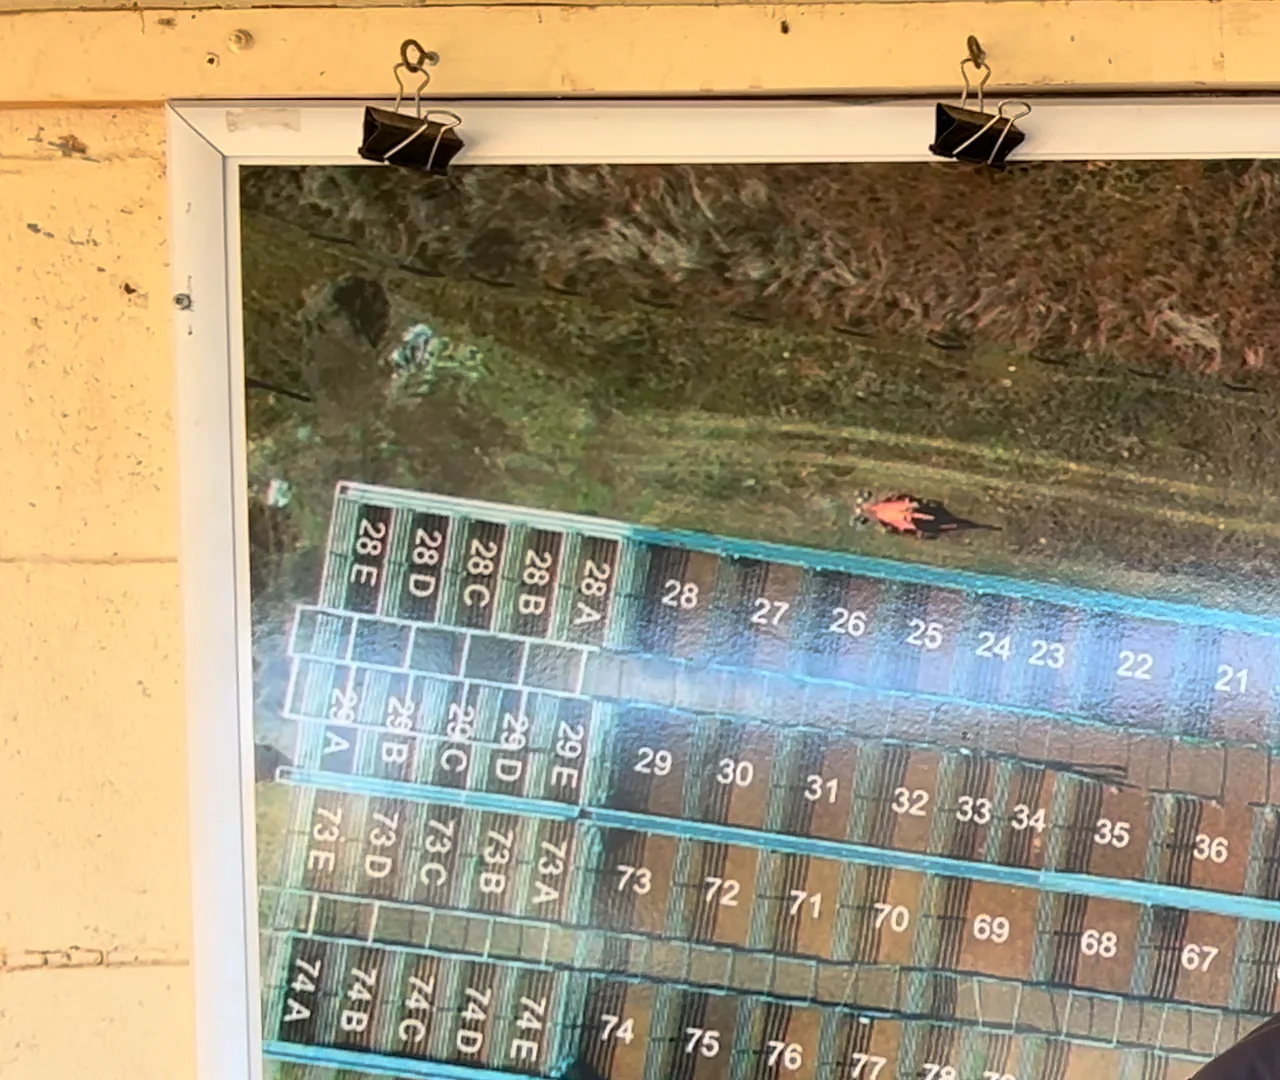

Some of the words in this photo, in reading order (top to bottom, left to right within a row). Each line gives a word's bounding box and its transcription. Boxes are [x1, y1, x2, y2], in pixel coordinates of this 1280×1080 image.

[356, 519, 385, 555] 28
[412, 528, 442, 566] 28
[467, 538, 497, 576] 28
[522, 549, 552, 586] 28
[350, 565, 378, 587] E
[409, 574, 436, 597] D
[580, 560, 610, 597] 28
[463, 584, 490, 607] C
[518, 593, 545, 615] B
[661, 579, 699, 610] 28
[573, 602, 601, 626] A
[751, 597, 790, 628] 27
[829, 607, 866, 638] 26
[905, 619, 943, 649] 25
[975, 631, 1011, 661] 24
[1028, 639, 1065, 669] 23
[1116, 651, 1154, 680] 22
[1214, 664, 1249, 694] 21
[386, 696, 415, 732] 29
[446, 703, 475, 743] 29
[324, 731, 349, 754] A
[501, 713, 528, 750] 29
[556, 721, 585, 758] 29
[382, 742, 408, 764] B
[440, 749, 467, 773] C
[634, 747, 672, 777] 29
[495, 758, 522, 782] D
[551, 766, 578, 788] E
[716, 758, 754, 788] 30
[804, 774, 838, 804] 31
[891, 787, 929, 818] 32
[313, 807, 342, 842] 73
[955, 796, 991, 824] 33
[1011, 804, 1046, 834] 34
[369, 812, 399, 847] 73
[425, 818, 454, 854] 73
[1093, 818, 1130, 849] 35
[308, 849, 335, 872] E
[483, 829, 513, 864] 73
[538, 840, 566, 876] 73
[1192, 834, 1229, 864] 36
[365, 855, 392, 878] D
[421, 863, 447, 887] C
[616, 865, 652, 895] 73
[479, 872, 506, 893] B
[532, 881, 559, 904] A
[704, 877, 740, 908] 72
[788, 890, 822, 919] 71
[873, 903, 909, 933] 70
[972, 914, 1010, 944] 69
[1080, 929, 1117, 958] 68
[1180, 944, 1219, 973] 67
[290, 958, 321, 993] 74
[347, 967, 377, 1003] 74
[403, 975, 434, 1012] 74
[461, 988, 491, 1022] 74
[283, 999, 311, 1022] A
[340, 1010, 368, 1032] B
[516, 996, 546, 1031] 74
[399, 1019, 425, 1043] C
[457, 1030, 483, 1054] D
[600, 1015, 634, 1045] 74
[683, 1028, 720, 1058] 75
[510, 1039, 538, 1062] E
[766, 1040, 803, 1071] 76
